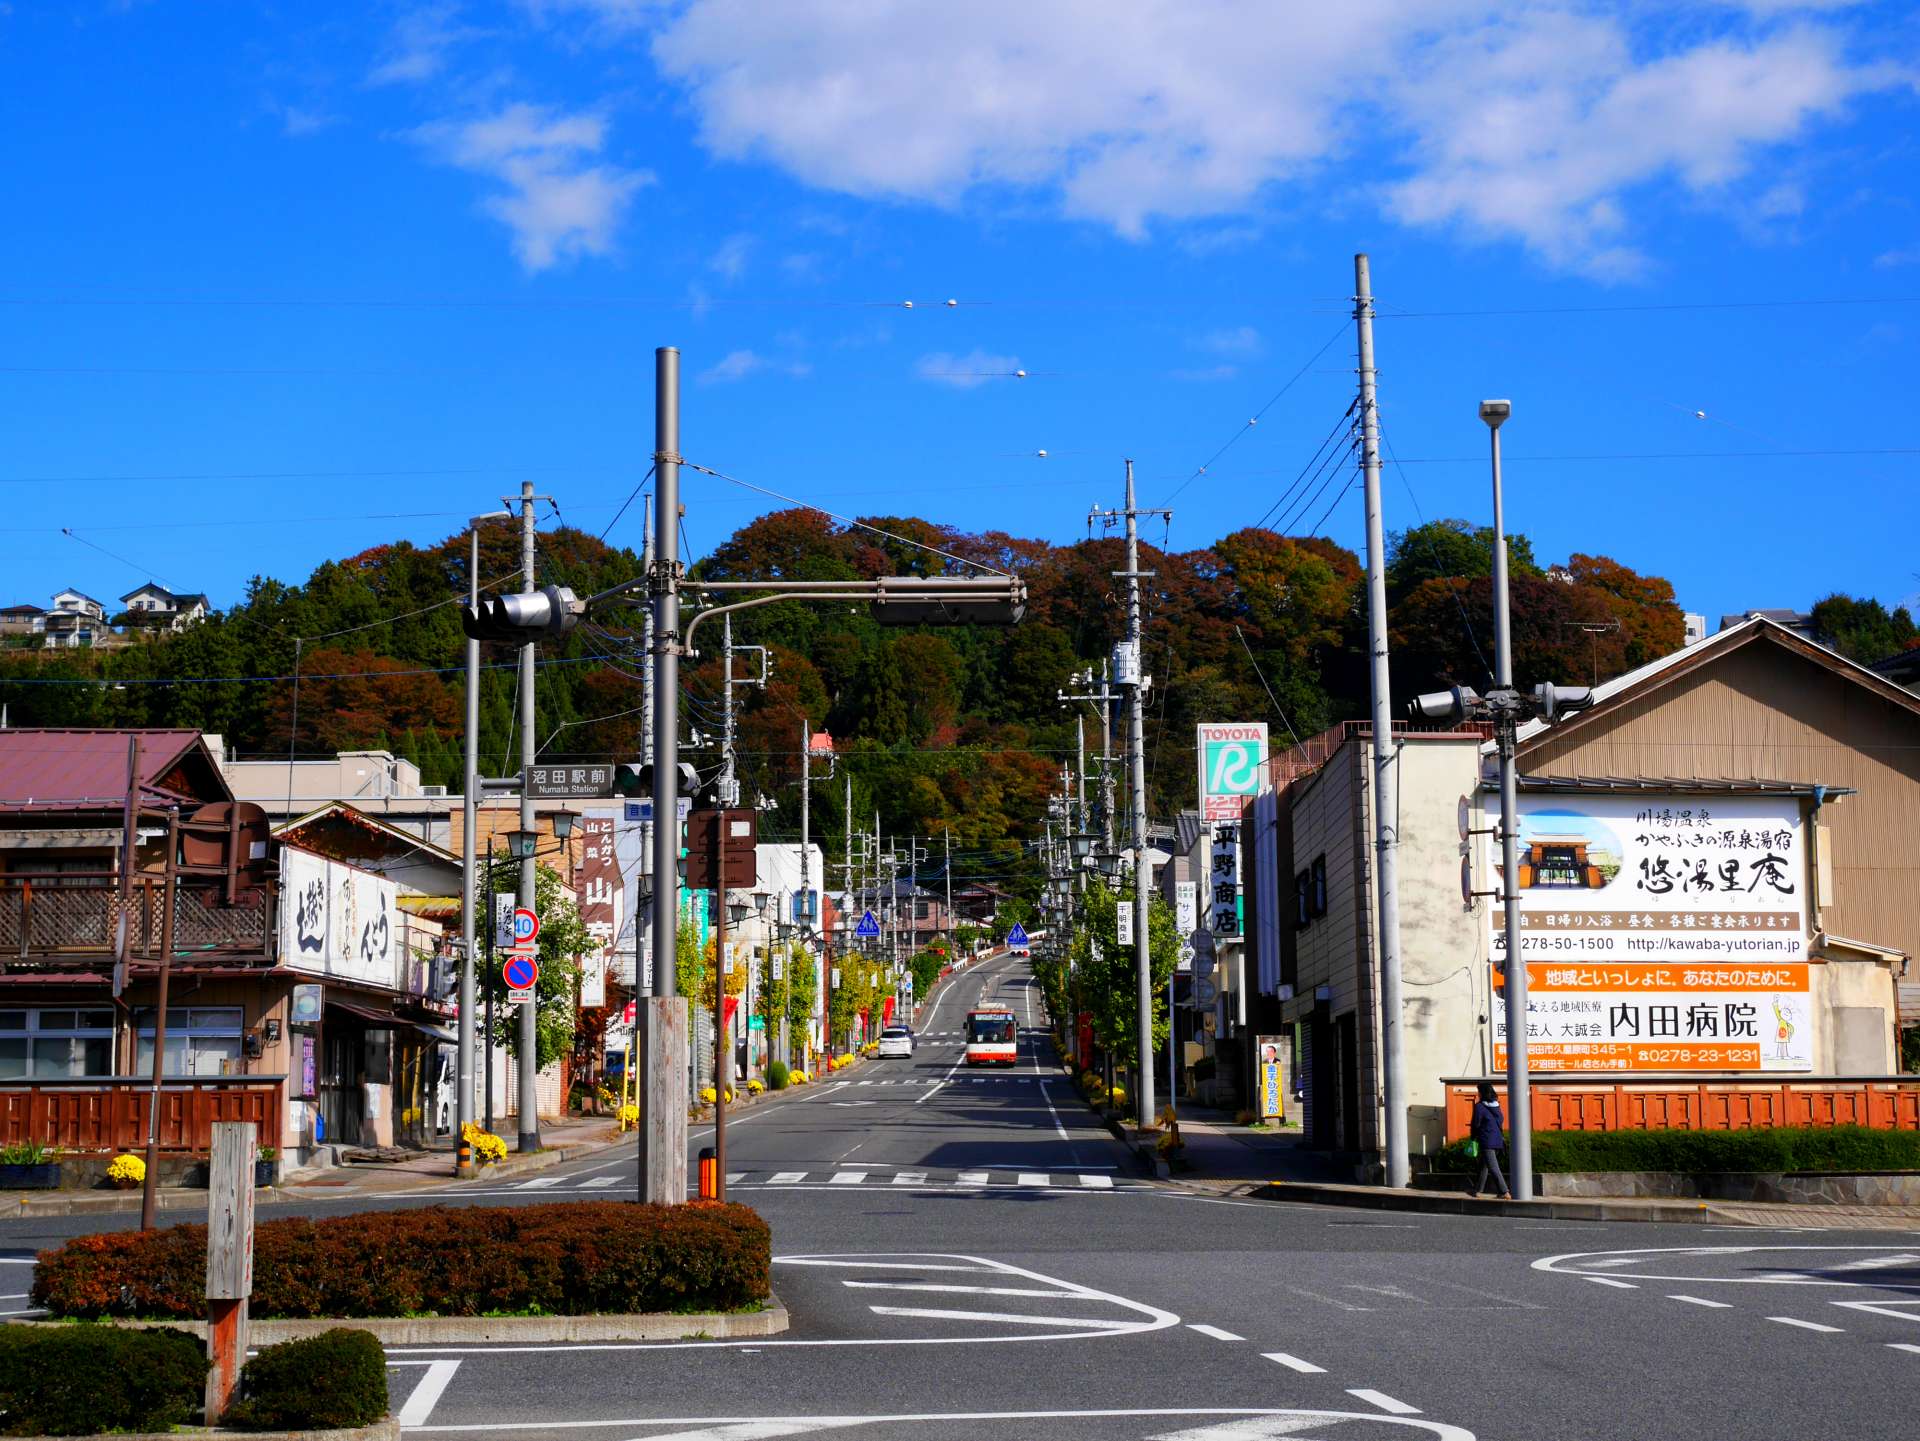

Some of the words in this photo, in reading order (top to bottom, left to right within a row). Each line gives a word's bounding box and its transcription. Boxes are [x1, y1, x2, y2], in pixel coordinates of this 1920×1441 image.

[1203, 728, 1262, 740] TOYOTA
[532, 769, 605, 784] 沼田駅前
[539, 785, 568, 793] Numata
[571, 784, 599, 793] Station
[1205, 796, 1242, 808] レンタ
[1636, 808, 1713, 828] 川場温泉
[600, 821, 612, 867] とんかつ
[1213, 825, 1237, 933] 平野商店
[1637, 852, 1795, 895] 悠湯里庵
[1521, 937, 1614, 950] 278-50-1500
[1627, 937, 1800, 953] http://kawaba-yutorian.jp
[1545, 969, 1677, 986] 地域といっしょに。
[1683, 969, 1797, 986] あなたのために。
[1609, 1002, 1758, 1037] 内田病院
[1497, 1024, 1552, 1037] 医法人
[1561, 1024, 1602, 1037] 大誠会
[1649, 1049, 1758, 1062] 0278-23-1231
